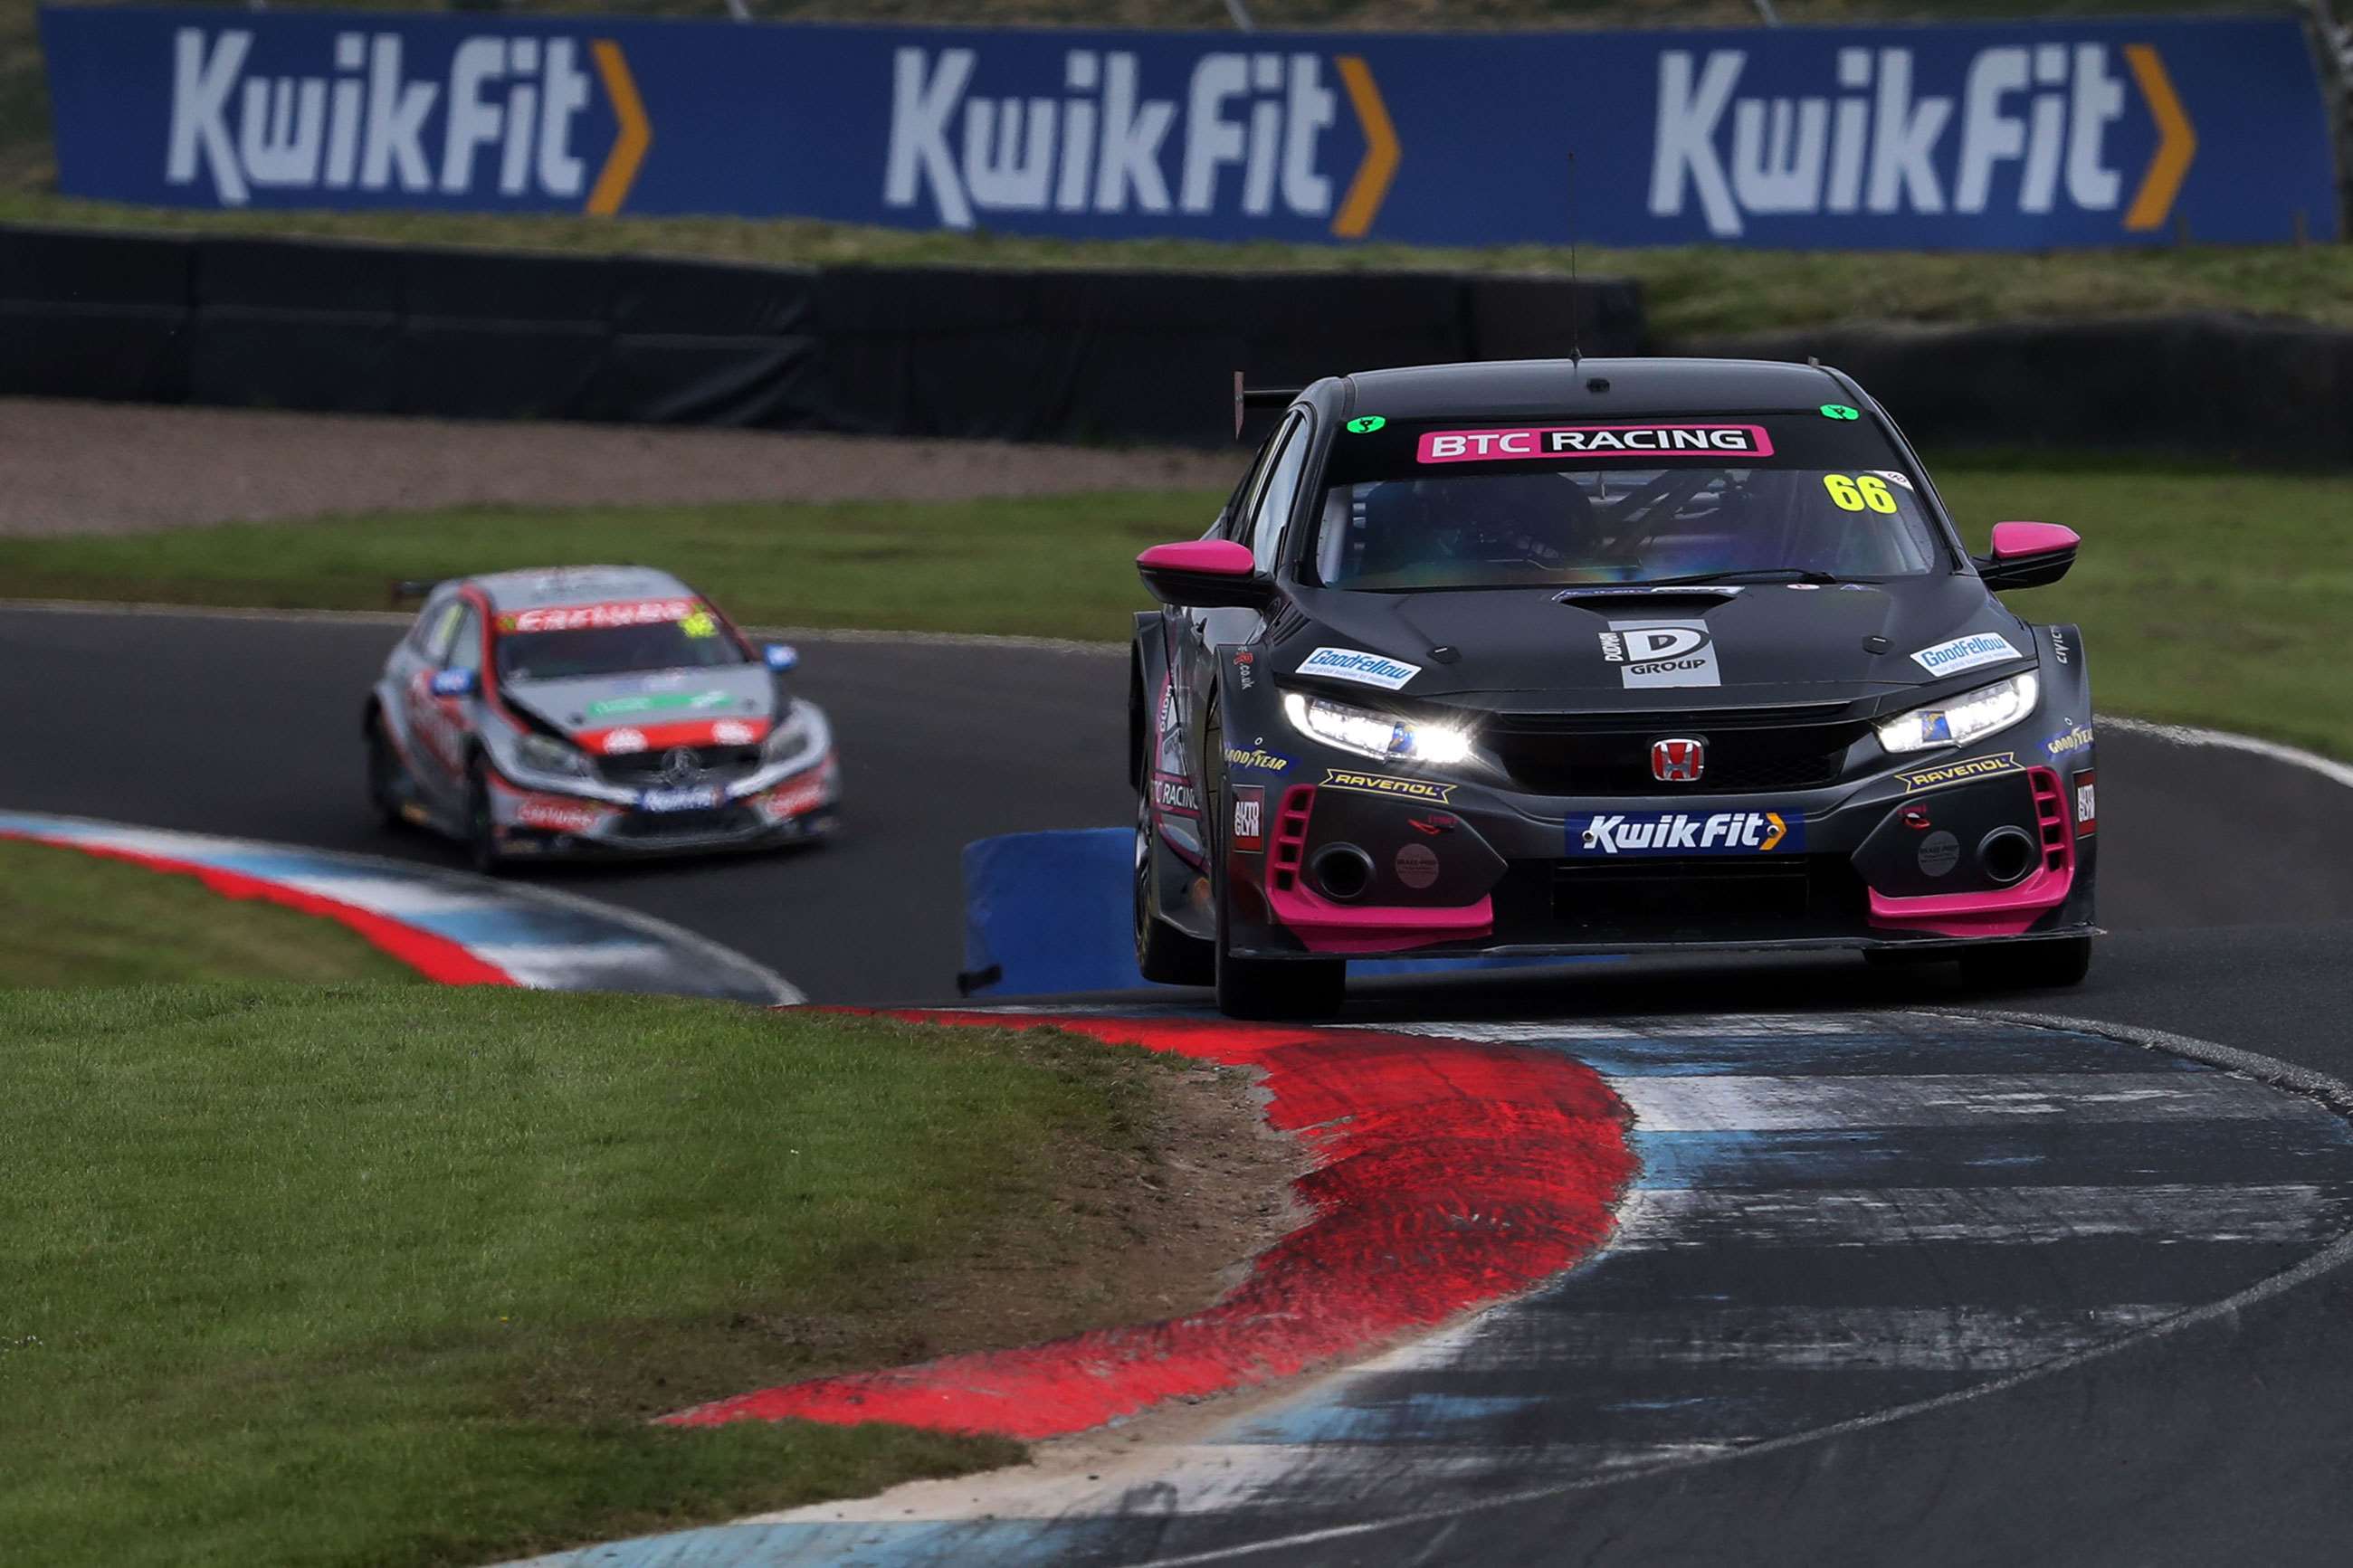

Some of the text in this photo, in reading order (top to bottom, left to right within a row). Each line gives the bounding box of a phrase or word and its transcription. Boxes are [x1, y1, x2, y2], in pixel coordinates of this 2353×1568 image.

[1432, 430, 1748, 457] BTC RACING
[1824, 474, 1898, 514] 66
[1309, 651, 1412, 679] GoodFellow
[1921, 637, 2007, 667] GoodFellow
[1631, 660, 1706, 675] GROUP
[1335, 774, 1438, 796] RAVENOL
[1912, 759, 2010, 785] RAVENOL
[1234, 802, 1260, 820] AUTO
[1234, 818, 1260, 836] GLYM
